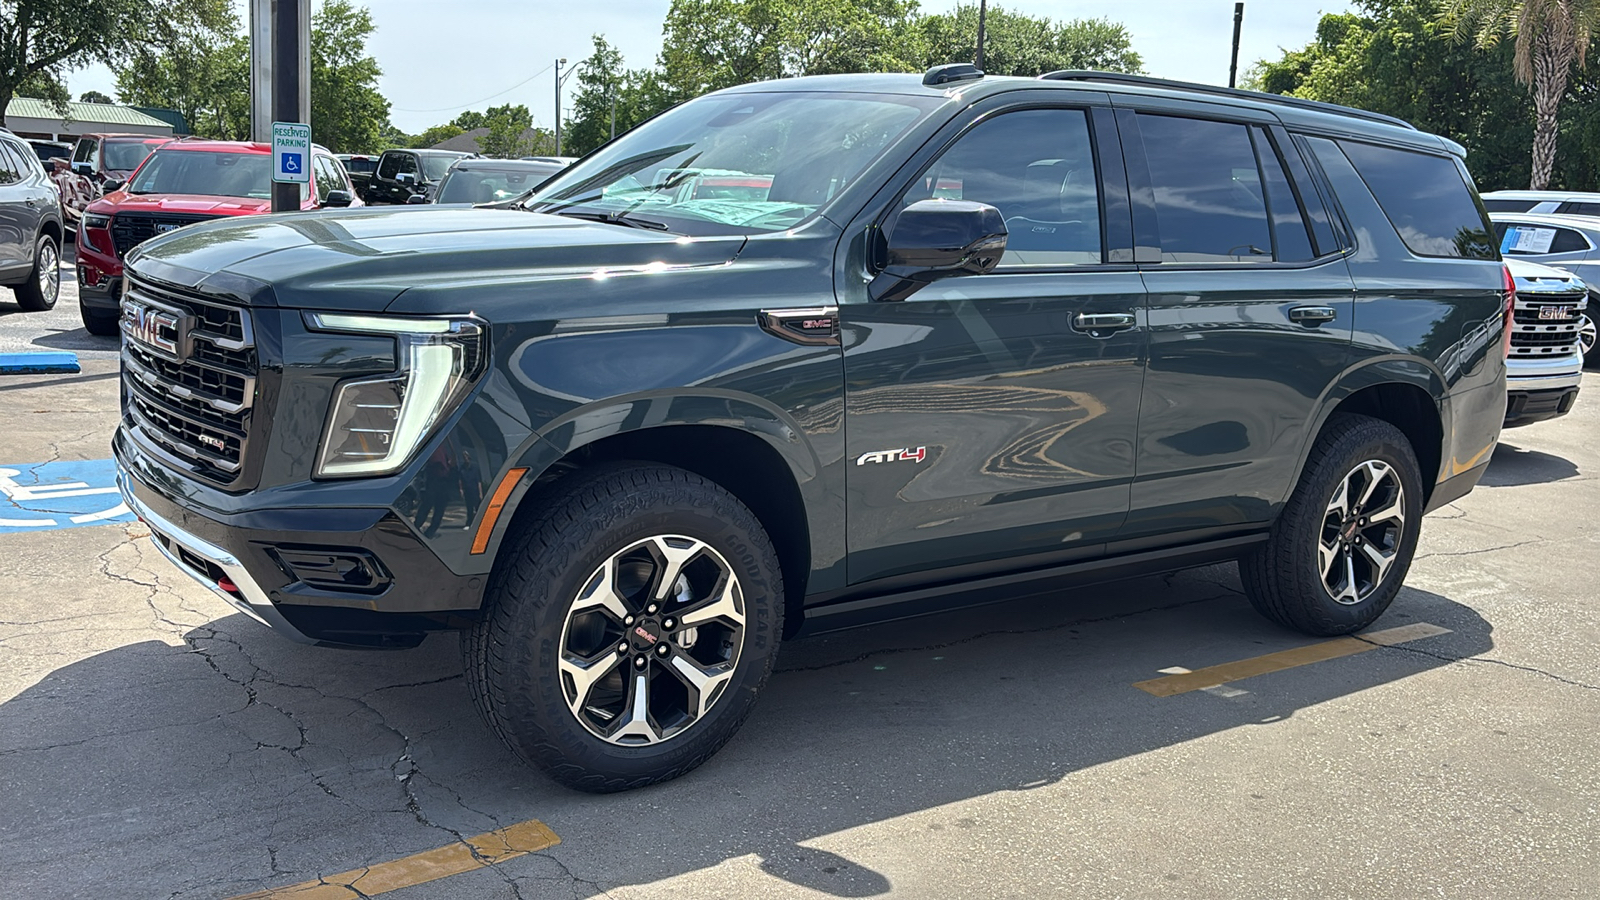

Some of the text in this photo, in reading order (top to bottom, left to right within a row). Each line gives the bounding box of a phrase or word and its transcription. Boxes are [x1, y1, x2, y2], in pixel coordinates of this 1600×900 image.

[274, 128, 308, 138] RESERVED
[277, 139, 306, 148] PARKING
[1538, 306, 1573, 319] GMC
[124, 302, 177, 354] GMC
[803, 320, 831, 328] GMC
[199, 435, 224, 451] AT4
[857, 446, 926, 465] AT4
[635, 626, 657, 644] GMC
